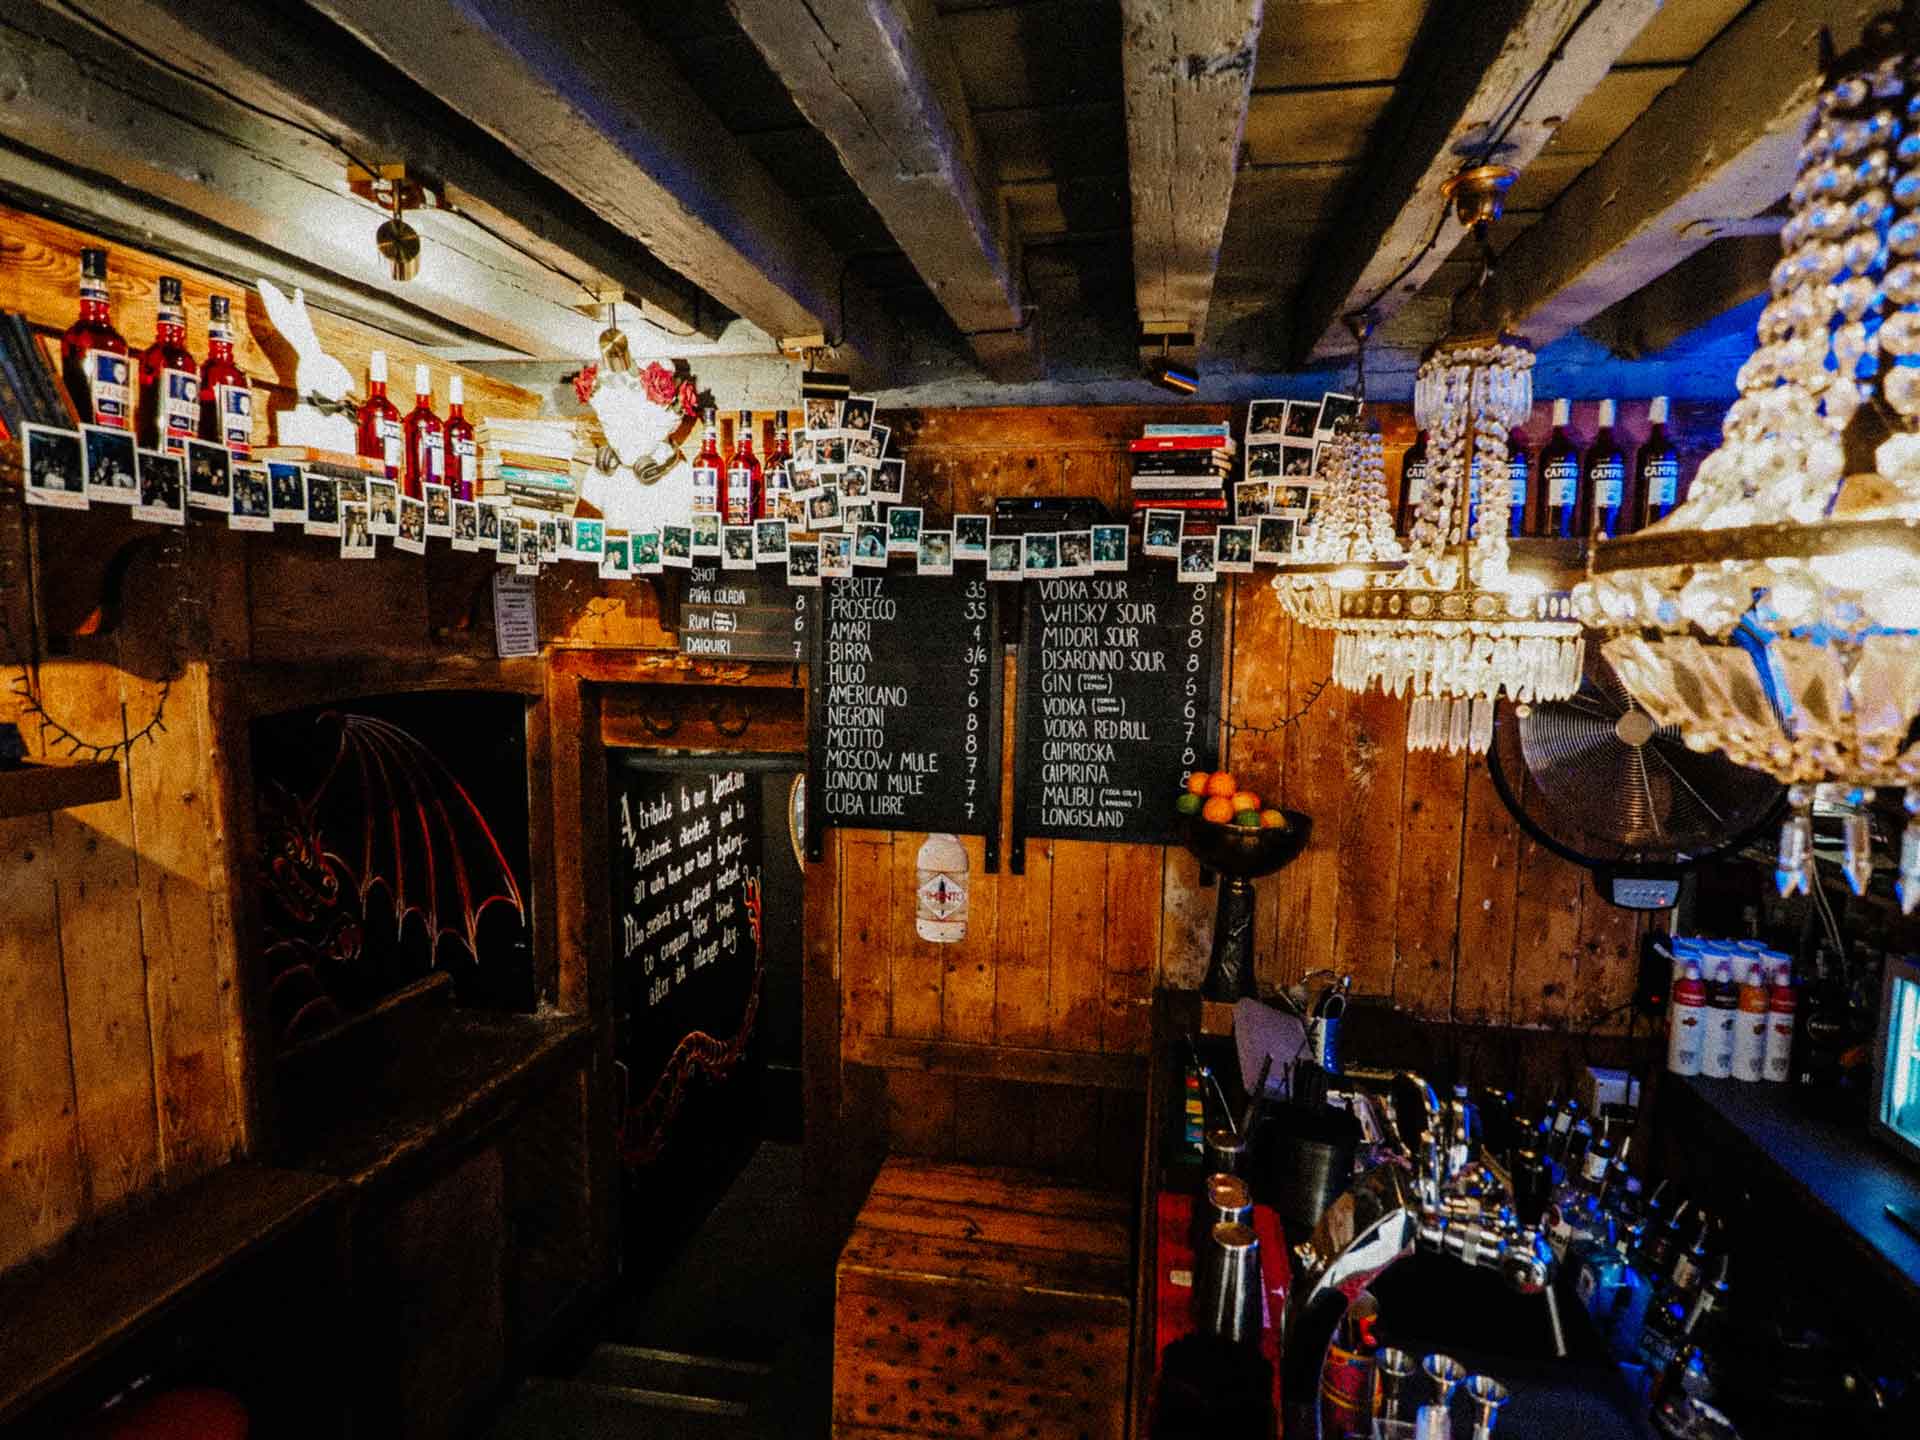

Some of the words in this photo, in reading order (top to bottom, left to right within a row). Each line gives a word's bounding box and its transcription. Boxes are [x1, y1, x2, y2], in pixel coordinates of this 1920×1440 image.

[691, 566, 718, 582] SHOT
[689, 586, 711, 604] PIÑA
[713, 589, 746, 605] COLADA
[795, 594, 805, 610] 8
[830, 577, 884, 598] SPRITZ
[1040, 580, 1089, 600] VODKA
[1092, 580, 1128, 600] SOUR
[1193, 583, 1206, 601] 8
[831, 598, 896, 620] PROSECCO
[1041, 603, 1108, 624] WHISKY
[1116, 603, 1156, 625] SOUR
[1190, 605, 1205, 626] 8
[688, 614, 710, 631] RUM
[794, 615, 804, 631] 6
[829, 621, 871, 641] AMARI
[973, 624, 981, 642] 4
[687, 636, 730, 656] DAIQUIRI
[792, 641, 802, 658] 7
[1041, 626, 1099, 648] MIDORI
[1104, 626, 1139, 648] SOUR
[1187, 629, 1202, 648] 8
[829, 641, 873, 662] BIRRA
[964, 645, 987, 666] 3/6
[1042, 649, 1124, 671] DISARONNO
[1129, 651, 1167, 672] SOUR
[1186, 654, 1199, 672] 8
[829, 664, 866, 684] HUGO
[967, 668, 980, 687] 5
[1041, 672, 1072, 693] GIN
[828, 685, 908, 707] AMERICANO
[967, 691, 979, 708] 6
[1043, 697, 1088, 716] VODKA
[1184, 700, 1196, 719] 6
[828, 706, 884, 728] NEGRONI
[967, 713, 978, 731] 8
[827, 727, 884, 749] MOJITO
[965, 734, 977, 753] 8
[1043, 719, 1088, 739] VODKA
[1183, 721, 1196, 743] 7
[826, 749, 893, 770] MOSCOW
[900, 751, 939, 772] MULE
[966, 756, 978, 774] 7
[1042, 741, 1117, 762] CAIPIROSKA
[1182, 747, 1195, 765] 8
[826, 770, 878, 791] LONDON
[887, 774, 924, 795] MULE
[965, 779, 977, 796] 7
[825, 791, 865, 815] CUBA
[870, 795, 905, 816] LIBRE
[964, 802, 976, 820] 7
[1042, 786, 1095, 807] MALIBU
[621, 791, 637, 848] A
[640, 791, 672, 830] tribute
[681, 785, 691, 813] to
